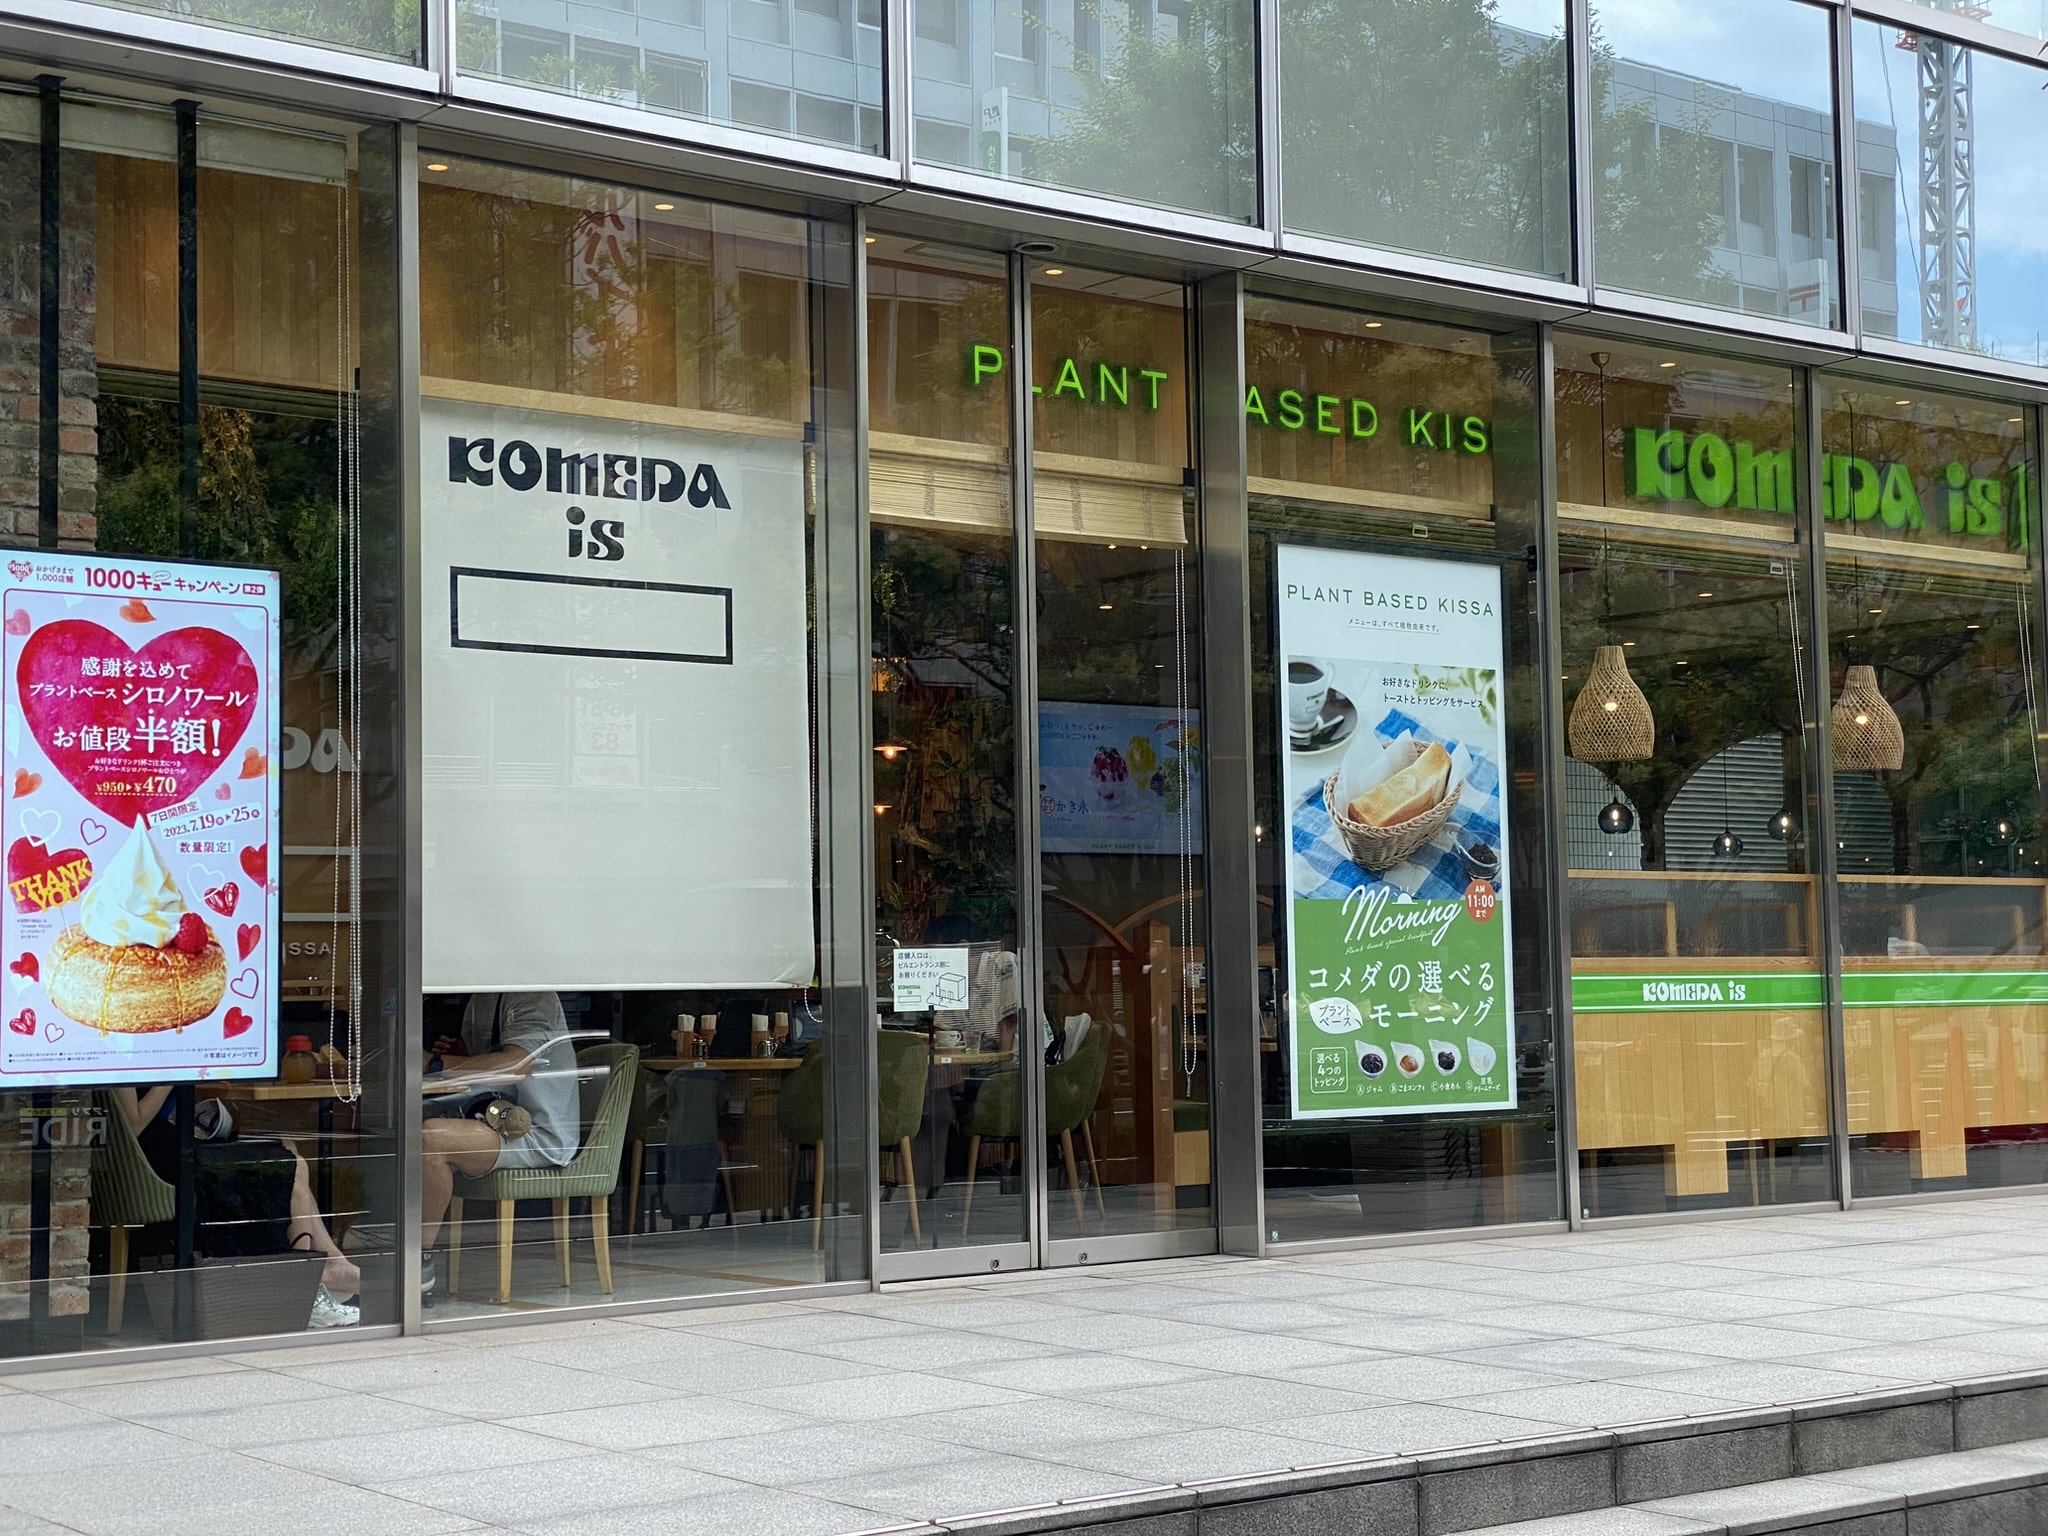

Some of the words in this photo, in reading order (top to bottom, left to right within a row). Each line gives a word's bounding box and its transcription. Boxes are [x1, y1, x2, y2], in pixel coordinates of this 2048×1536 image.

[448, 436, 731, 510] KOMEDA
[1946, 461, 2001, 536] is
[566, 506, 625, 561] is
[1288, 584, 1353, 605] PLANT
[1364, 591, 1428, 611] BASED
[1438, 598, 1494, 617] KISSA
[81, 657, 192, 681] 感謝を込めて
[1382, 677, 1449, 691] お好きなドリンクに、
[150, 801, 199, 823] 7日間限定
[180, 841, 231, 854] 数量限定!
[8, 857, 94, 902] THANK
[1475, 885, 1486, 893] AM
[28, 880, 81, 912] YOU
[1467, 894, 1494, 908] 11:00
[1341, 884, 1463, 948] Morning
[1475, 909, 1487, 918] まで
[1308, 960, 1495, 994] コメダの選べる
[1642, 982, 1722, 1002] KOMEDA
[1729, 980, 1746, 1001] is
[1319, 1003, 1352, 1019] プラント
[1319, 1017, 1352, 1027] ベース
[1369, 996, 1495, 1028] モーニング
[1316, 1053, 1340, 1064] 選べる
[1317, 1064, 1342, 1076] 4つの
[1314, 1076, 1345, 1088] トッピング
